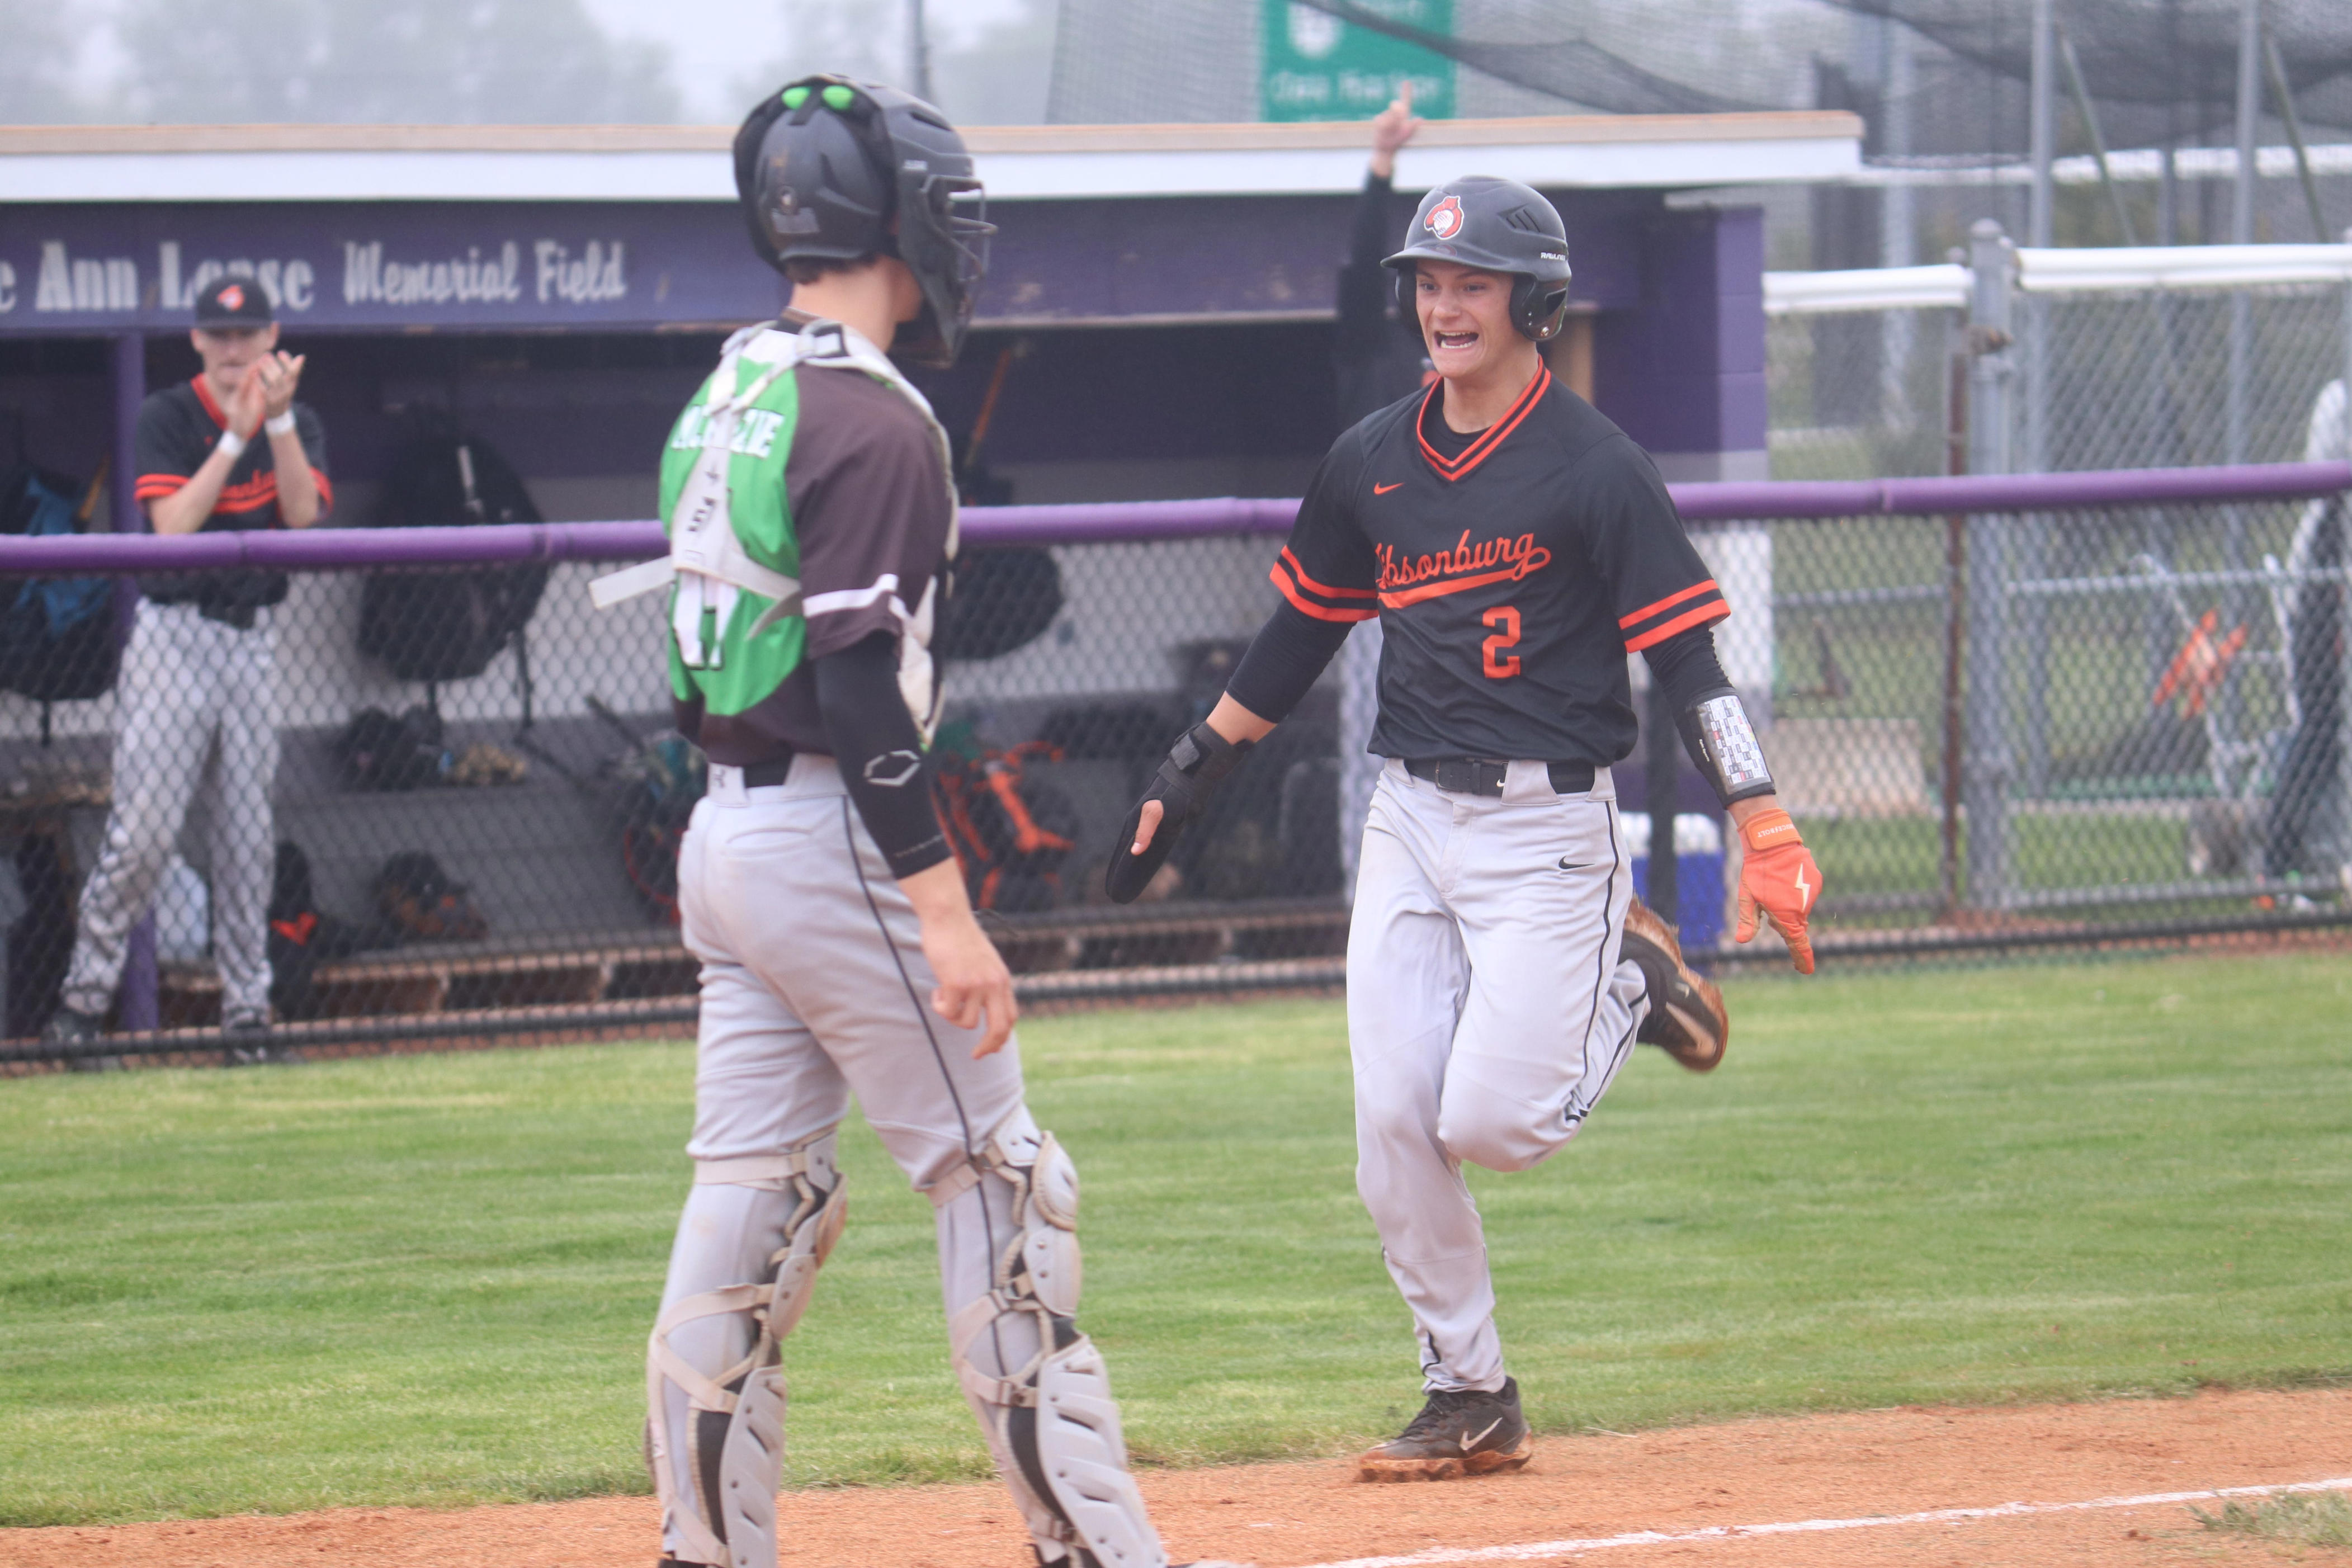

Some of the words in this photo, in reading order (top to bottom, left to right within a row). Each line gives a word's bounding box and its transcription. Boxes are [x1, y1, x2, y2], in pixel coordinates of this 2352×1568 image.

[35, 240, 139, 312] Ann
[160, 241, 313, 312] Lse
[344, 241, 521, 305] Memorial
[535, 241, 626, 303] Field
[1482, 605, 1520, 678] 2
